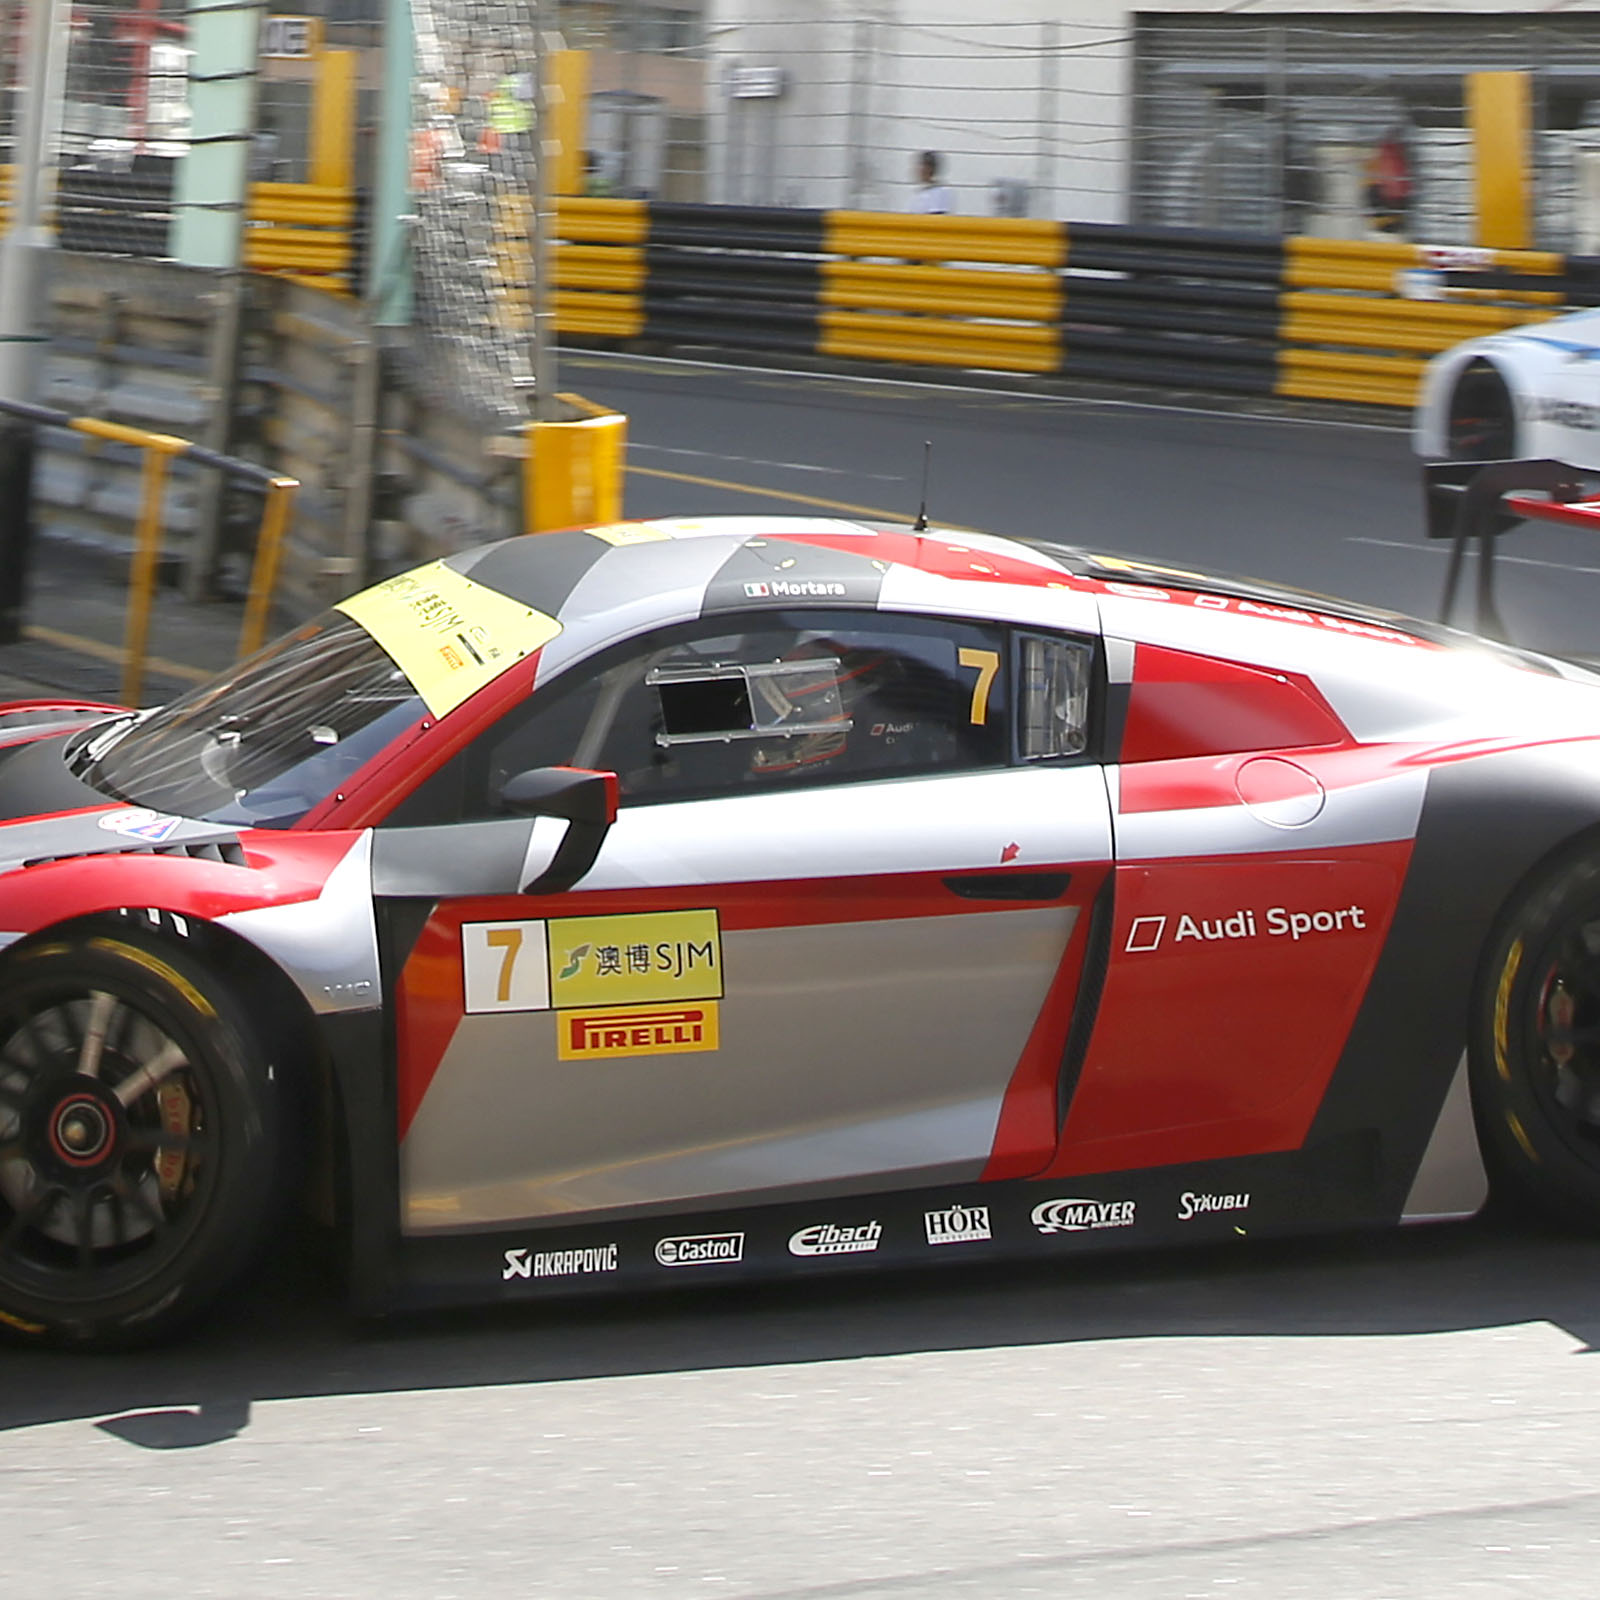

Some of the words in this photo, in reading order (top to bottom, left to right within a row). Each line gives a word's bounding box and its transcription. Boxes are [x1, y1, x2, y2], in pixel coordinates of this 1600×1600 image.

[770, 581, 846, 596] Mortara
[958, 647, 999, 726] 7
[1174, 910, 1256, 942] Audi
[1266, 905, 1366, 941] Sport
[486, 928, 522, 1002] 7
[570, 1009, 705, 1051] PIRELLI
[929, 1204, 988, 1236] HÖR
[1064, 1201, 1136, 1225] MAYER
[677, 1237, 737, 1260] Castrol
[788, 1220, 883, 1256] Eibach
